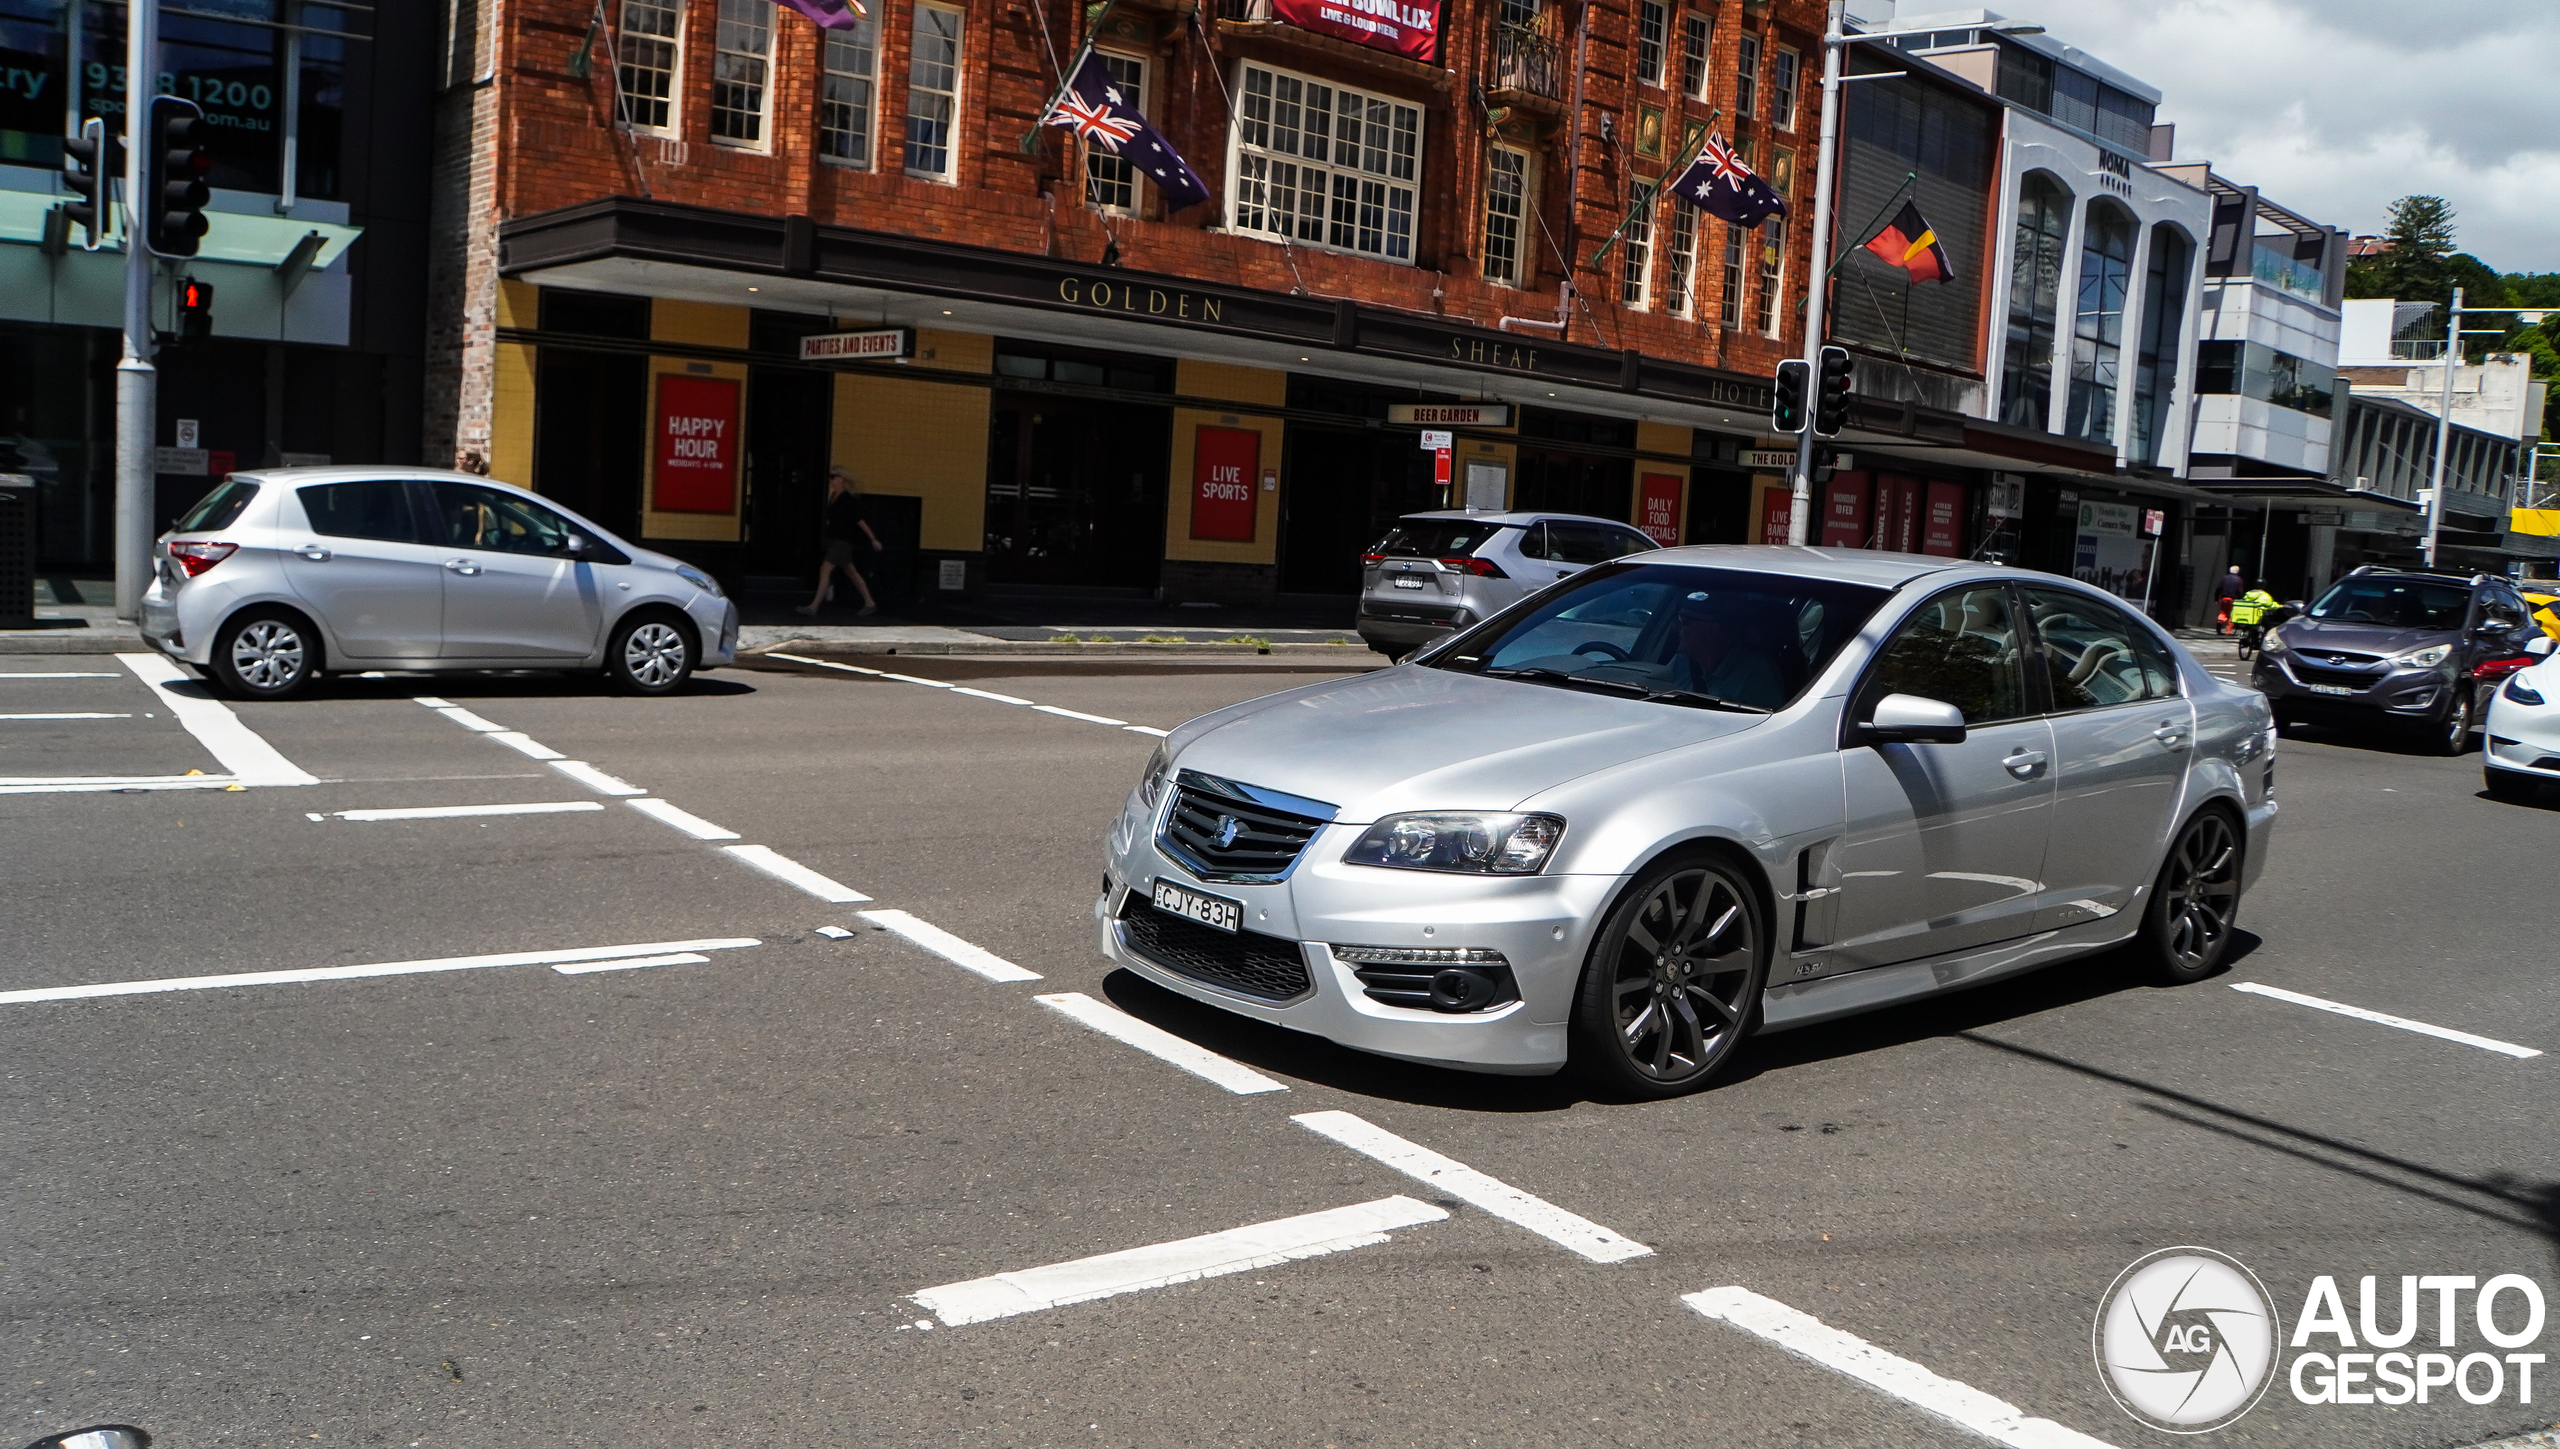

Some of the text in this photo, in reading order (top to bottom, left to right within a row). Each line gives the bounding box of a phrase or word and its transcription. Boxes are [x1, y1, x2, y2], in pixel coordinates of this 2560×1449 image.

[1321, 7, 1399, 39] LIVE & LOUD HERE
[1402, 5, 1432, 31] LIX
[189, 76, 272, 110] 1200
[805, 334, 897, 355] PARTIES AND EVENTS
[1060, 278, 1766, 406] GOLDEN SHEAF HOTE
[1414, 408, 1480, 422] BEER GARDEN
[668, 416, 725, 437] HAPPY
[674, 438, 718, 458] HOUR
[1752, 453, 1796, 465] THE GOLD
[1213, 465, 1240, 483] LIVE
[1202, 482, 1248, 500] SPORTS
[1648, 497, 1673, 512] DAILY
[1649, 512, 1670, 525] FOOD
[1772, 510, 1788, 524] LIVE
[2098, 518, 2132, 532] Camera Shop
[1640, 525, 1676, 540] SPECIALS
